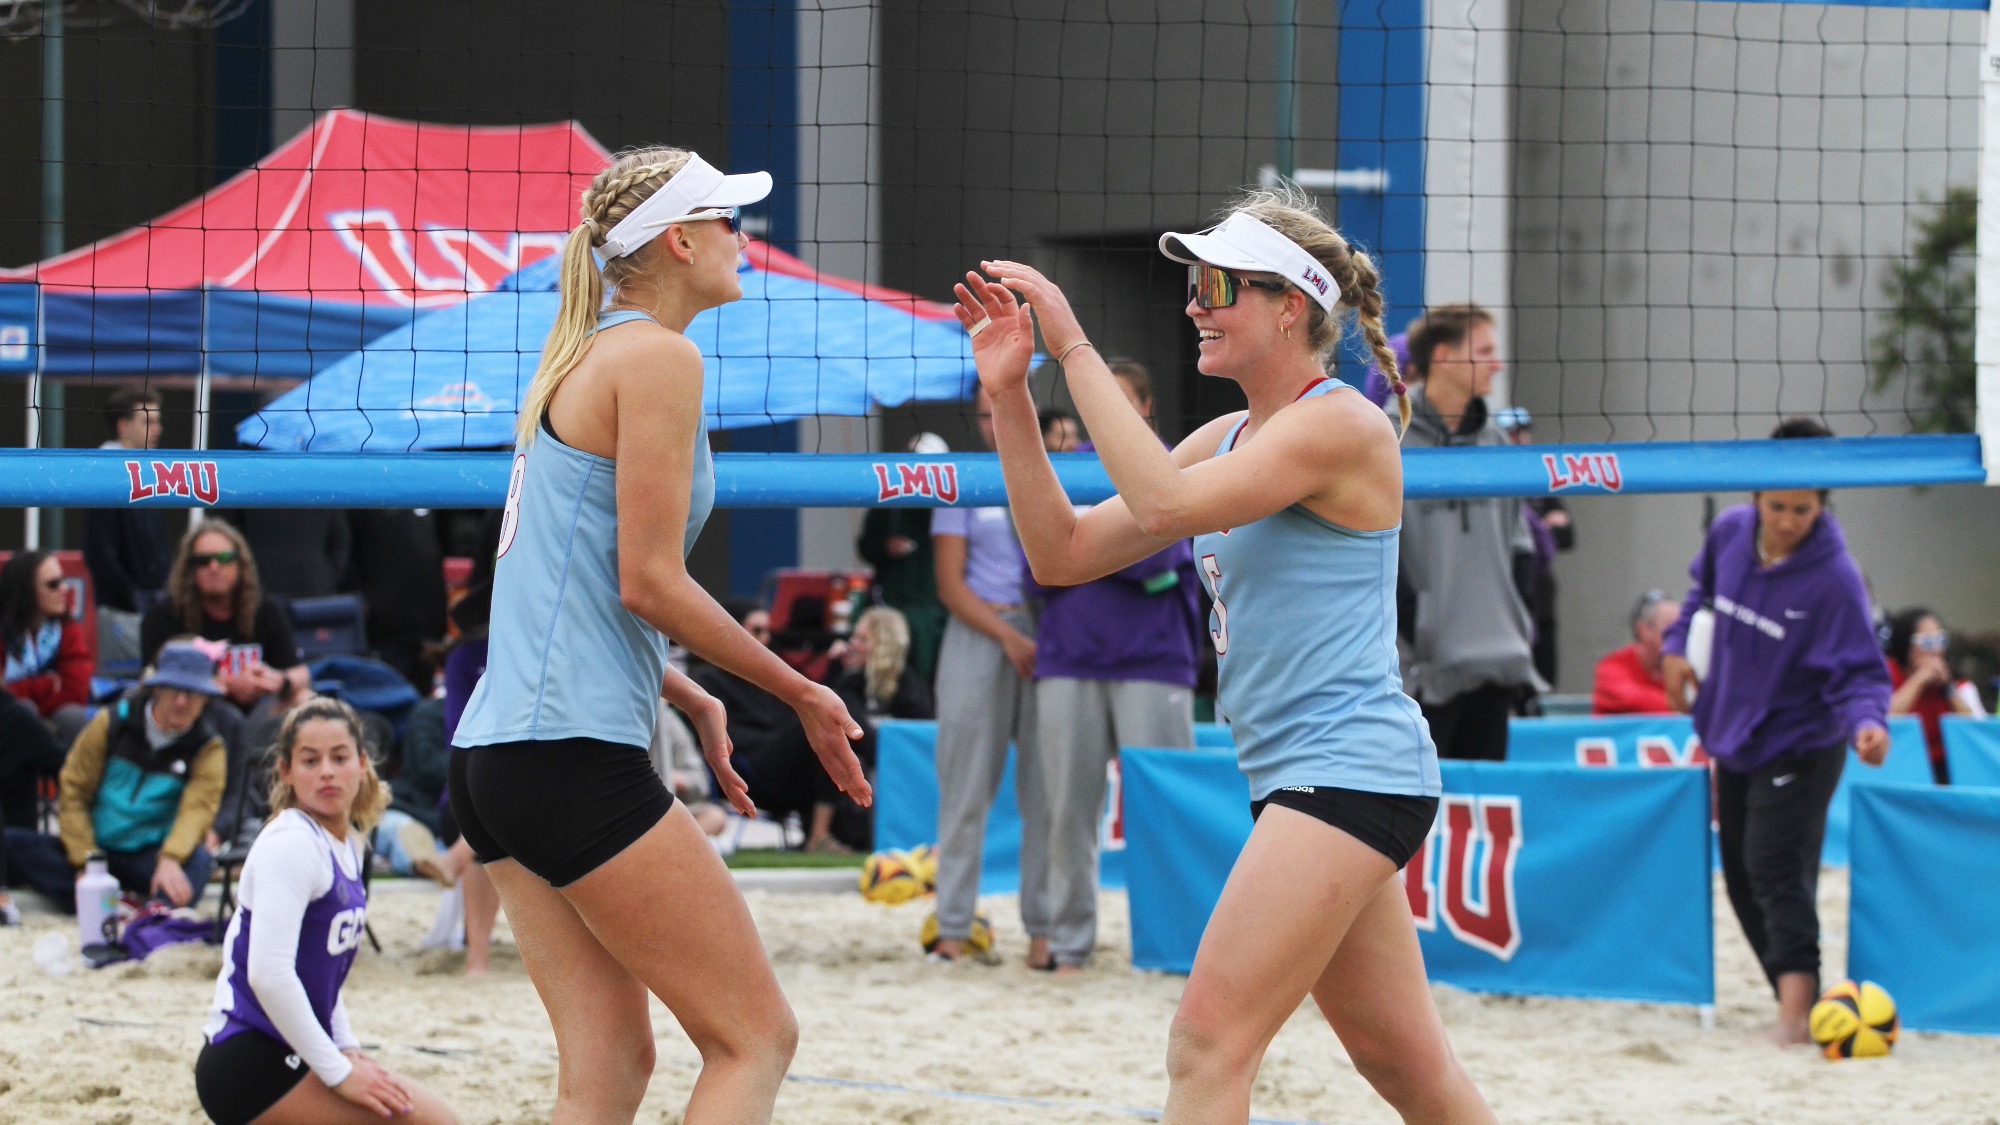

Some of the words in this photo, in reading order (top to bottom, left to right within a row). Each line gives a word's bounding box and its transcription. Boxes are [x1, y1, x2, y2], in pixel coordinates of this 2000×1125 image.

[1302, 265, 1330, 297] LMU
[125, 460, 219, 506] LMU
[872, 462, 959, 506] LMU
[1541, 452, 1624, 494] LMU
[1201, 553, 1229, 656] 5
